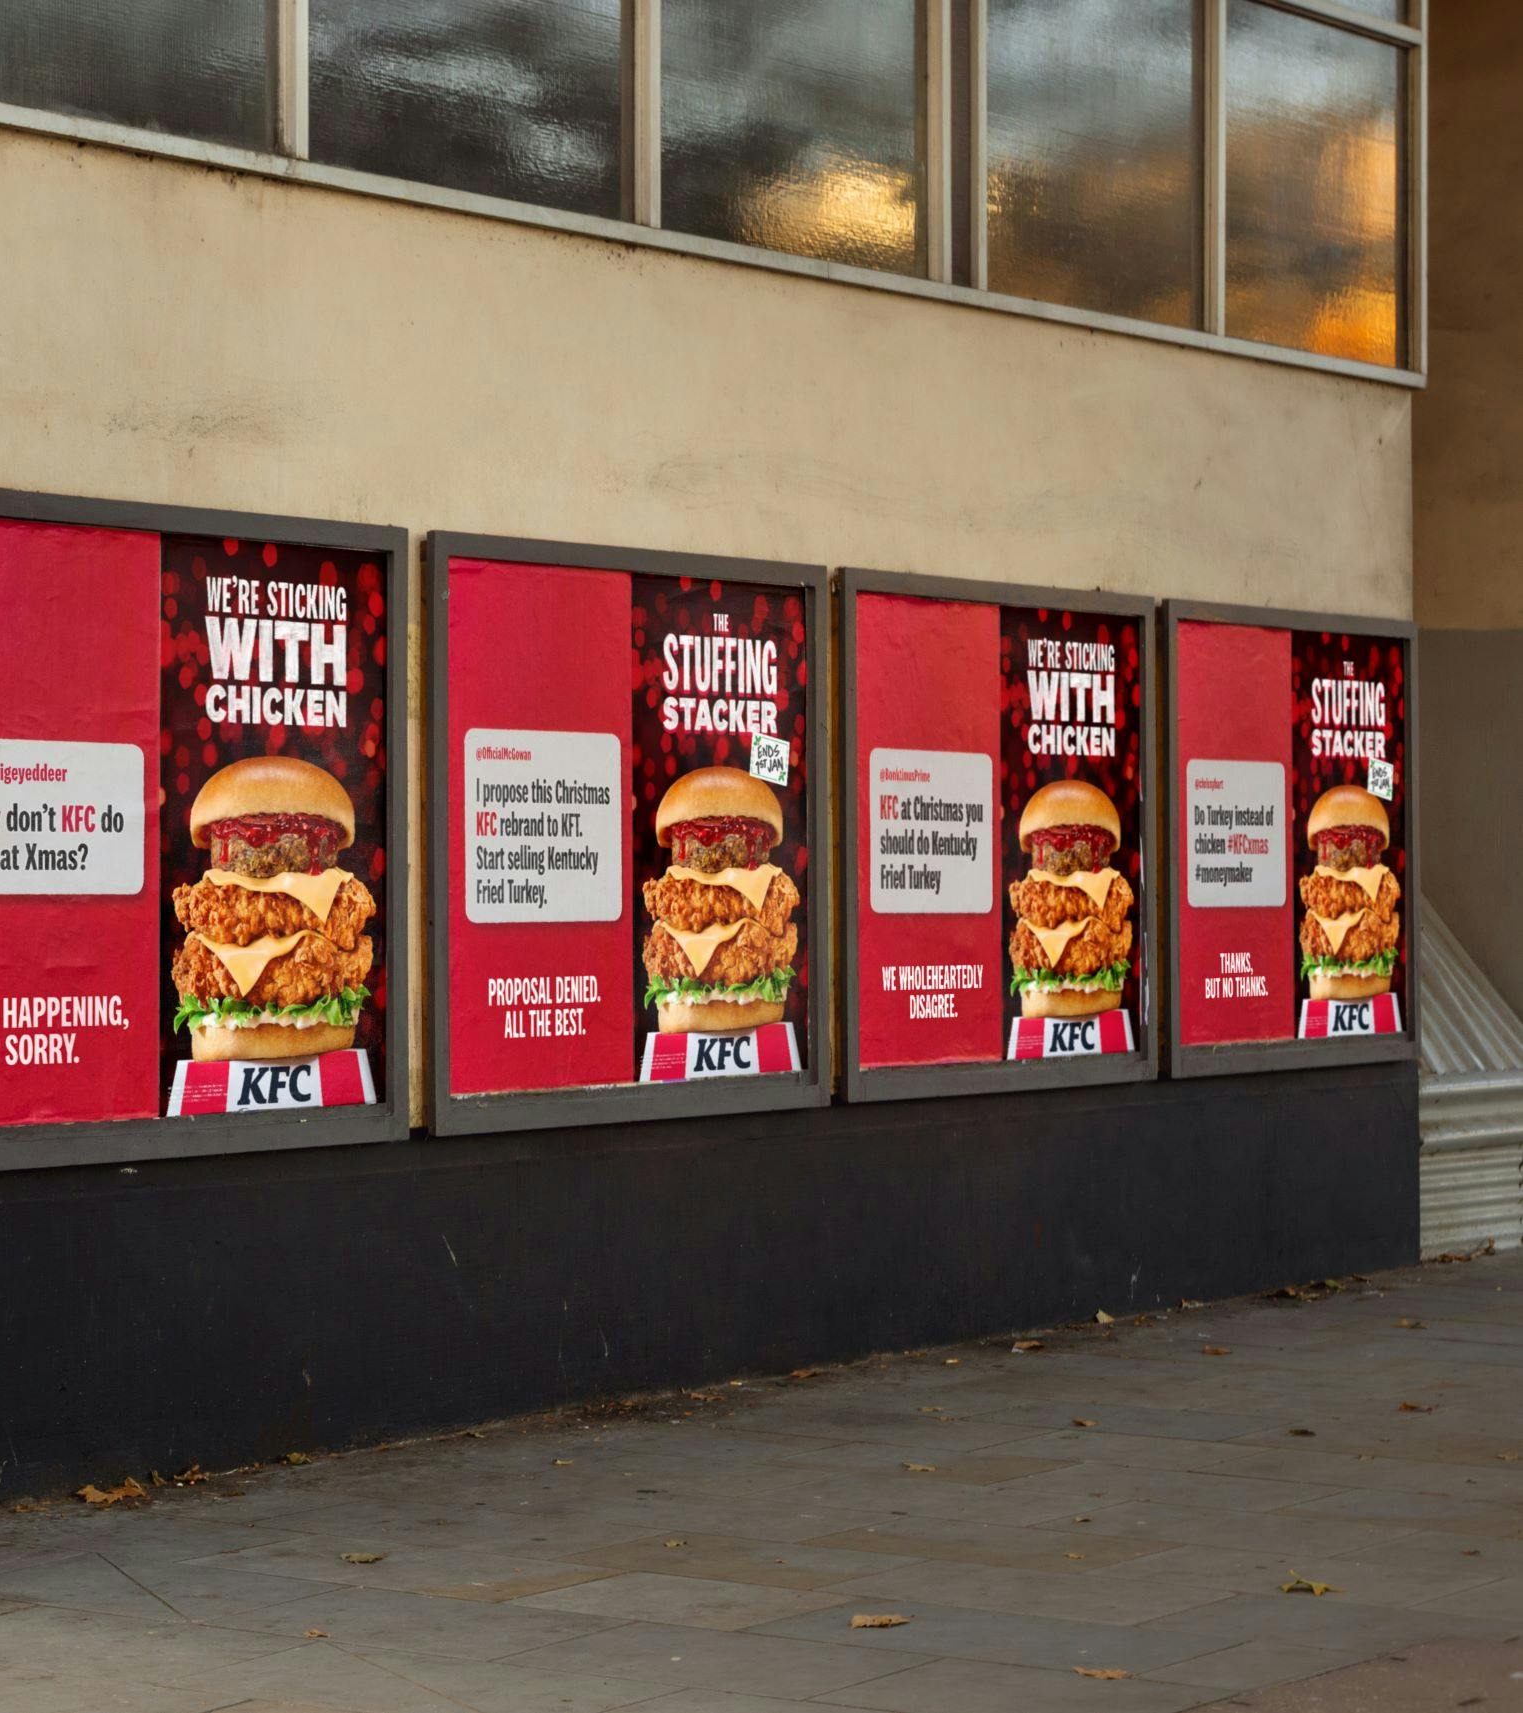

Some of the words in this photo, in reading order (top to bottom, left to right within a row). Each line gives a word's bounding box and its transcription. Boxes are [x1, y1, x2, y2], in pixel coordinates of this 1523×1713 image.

[206, 575, 260, 615] WE'RE
[266, 581, 347, 621] STICKING
[713, 613, 729, 632] THE
[205, 616, 347, 686] WITH
[663, 633, 777, 694] STUFFING
[1028, 637, 1061, 668] WE'RE
[1065, 641, 1115, 672] STICKING
[1343, 661, 1354, 676] THE
[205, 684, 347, 728] CHICKEN
[1027, 670, 1115, 724] WITH
[1312, 678, 1385, 726] STUFFING
[663, 696, 777, 734] STACKER
[476, 747, 532, 761] @OfficialMcGowan
[758, 745, 779, 759] ENDS
[1027, 724, 1115, 757] CHICKEN
[1312, 729, 1385, 758] STACKER
[755, 759, 767, 774] 1ST
[768, 757, 783, 773] JAN
[477, 778, 480, 803] I
[483, 783, 529, 808] propose
[532, 778, 552, 804] this
[556, 779, 610, 805] Christmas
[6, 803, 56, 832] don't
[62, 805, 95, 833] KFC
[101, 804, 124, 833] do
[477, 811, 497, 836] KFC
[500, 811, 544, 837] rebrand
[547, 815, 558, 837] to
[562, 813, 583, 837] KFT.
[880, 795, 898, 820] KFC
[901, 797, 911, 820] at
[913, 795, 963, 822] Christmas
[966, 803, 983, 827] you
[1195, 806, 1205, 826] Do
[1207, 805, 1233, 830] Turkey
[1235, 805, 1264, 826] instead
[1266, 805, 1274, 826] of
[0, 845, 19, 871] at
[25, 843, 88, 871] Xmas?
[880, 828, 914, 855] should
[917, 829, 929, 855] do
[932, 830, 977, 861] Kentucky
[1195, 833, 1225, 854] chicken
[1228, 834, 1269, 854] #KFCxmas
[477, 845, 505, 870] Start
[507, 845, 545, 875] selling
[548, 845, 598, 875] Kentucky
[1195, 861, 1253, 887] #moneymaker
[477, 879, 504, 904] Fried
[508, 879, 547, 909] Turkey.
[881, 864, 905, 889] Fried
[908, 864, 941, 895] Turkey
[882, 966, 896, 991] WE
[899, 965, 983, 991] WHOLEHEARTEDLY
[1220, 952, 1253, 975] THANKS,
[488, 977, 553, 1006] PROPOSAL
[556, 975, 601, 1003] DENIED.
[1205, 977, 1220, 999] BUT
[1223, 977, 1233, 998] NO
[1235, 976, 1268, 997] THANKS.
[3, 995, 129, 1030] HAPPENING,
[910, 994, 958, 1019] DISAGREE.
[1332, 1004, 1369, 1031] KFC
[504, 1010, 526, 1038] ALL
[529, 1009, 551, 1037] THE
[555, 1008, 586, 1036] BEST.
[1049, 1021, 1094, 1052] KFC
[5, 1033, 80, 1066] SORRY.
[694, 1036, 751, 1072] KFC
[237, 1064, 311, 1106] KFC
